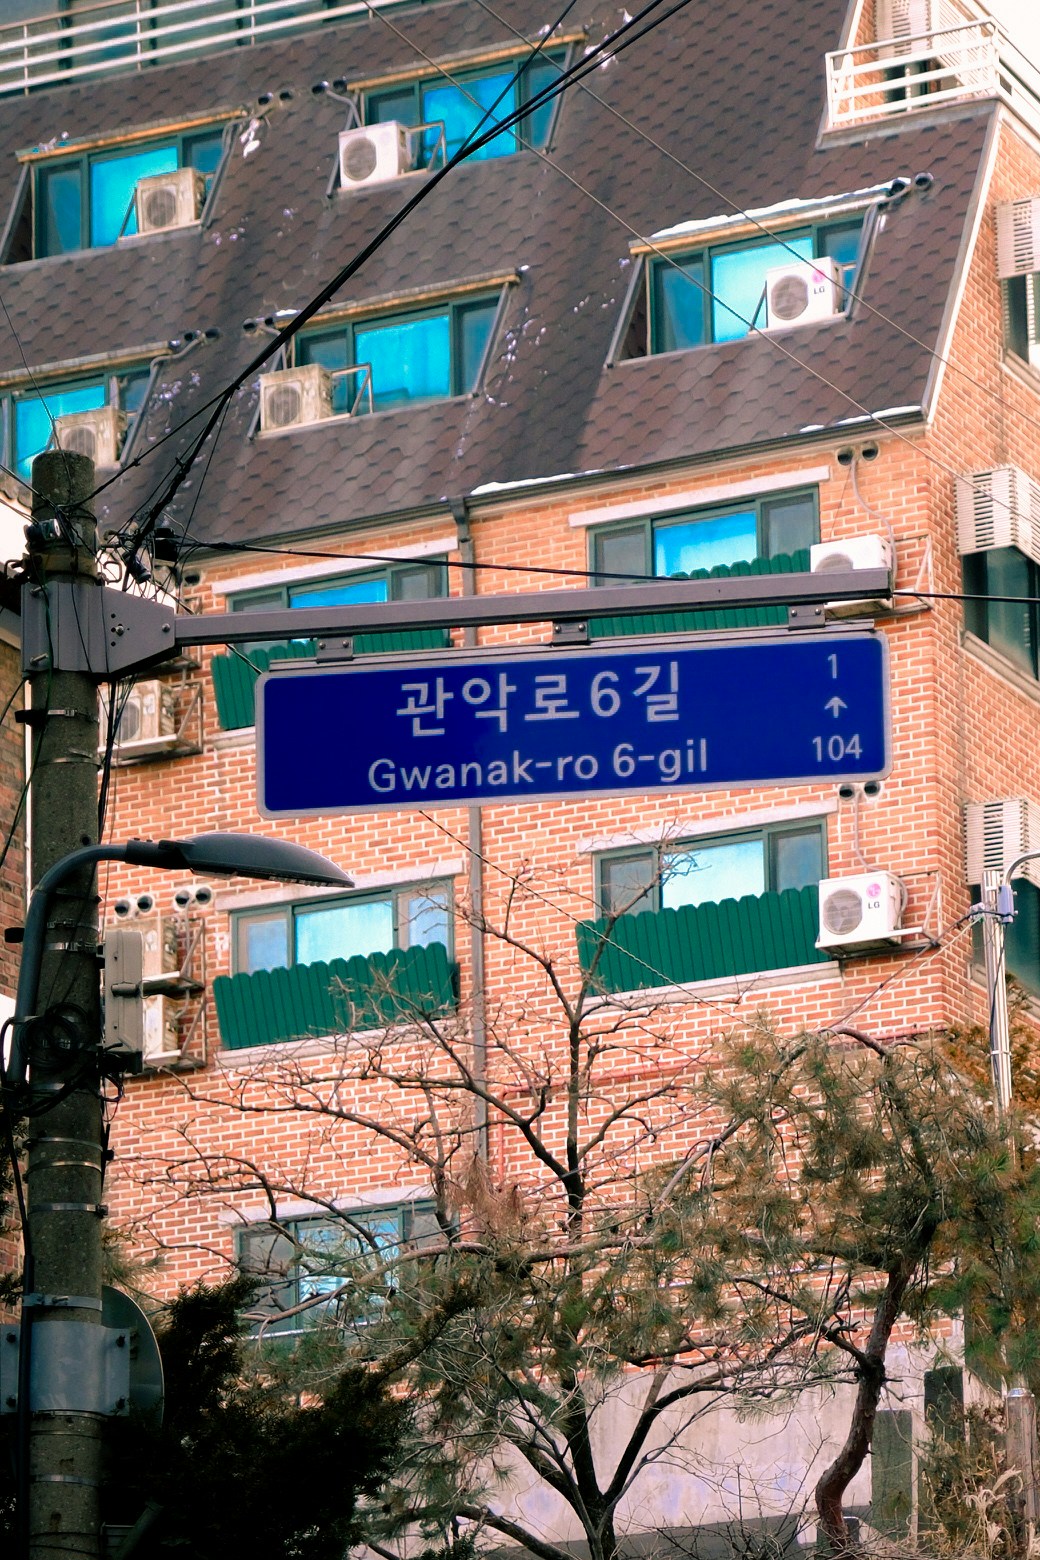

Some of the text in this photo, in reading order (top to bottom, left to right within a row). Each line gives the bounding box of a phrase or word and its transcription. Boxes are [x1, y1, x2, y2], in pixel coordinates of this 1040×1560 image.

[827, 653, 838, 679] 1
[396, 661, 680, 737] 관악로6길
[368, 738, 707, 793] Gwanak-ro 6-gil
[812, 733, 863, 762] 104
